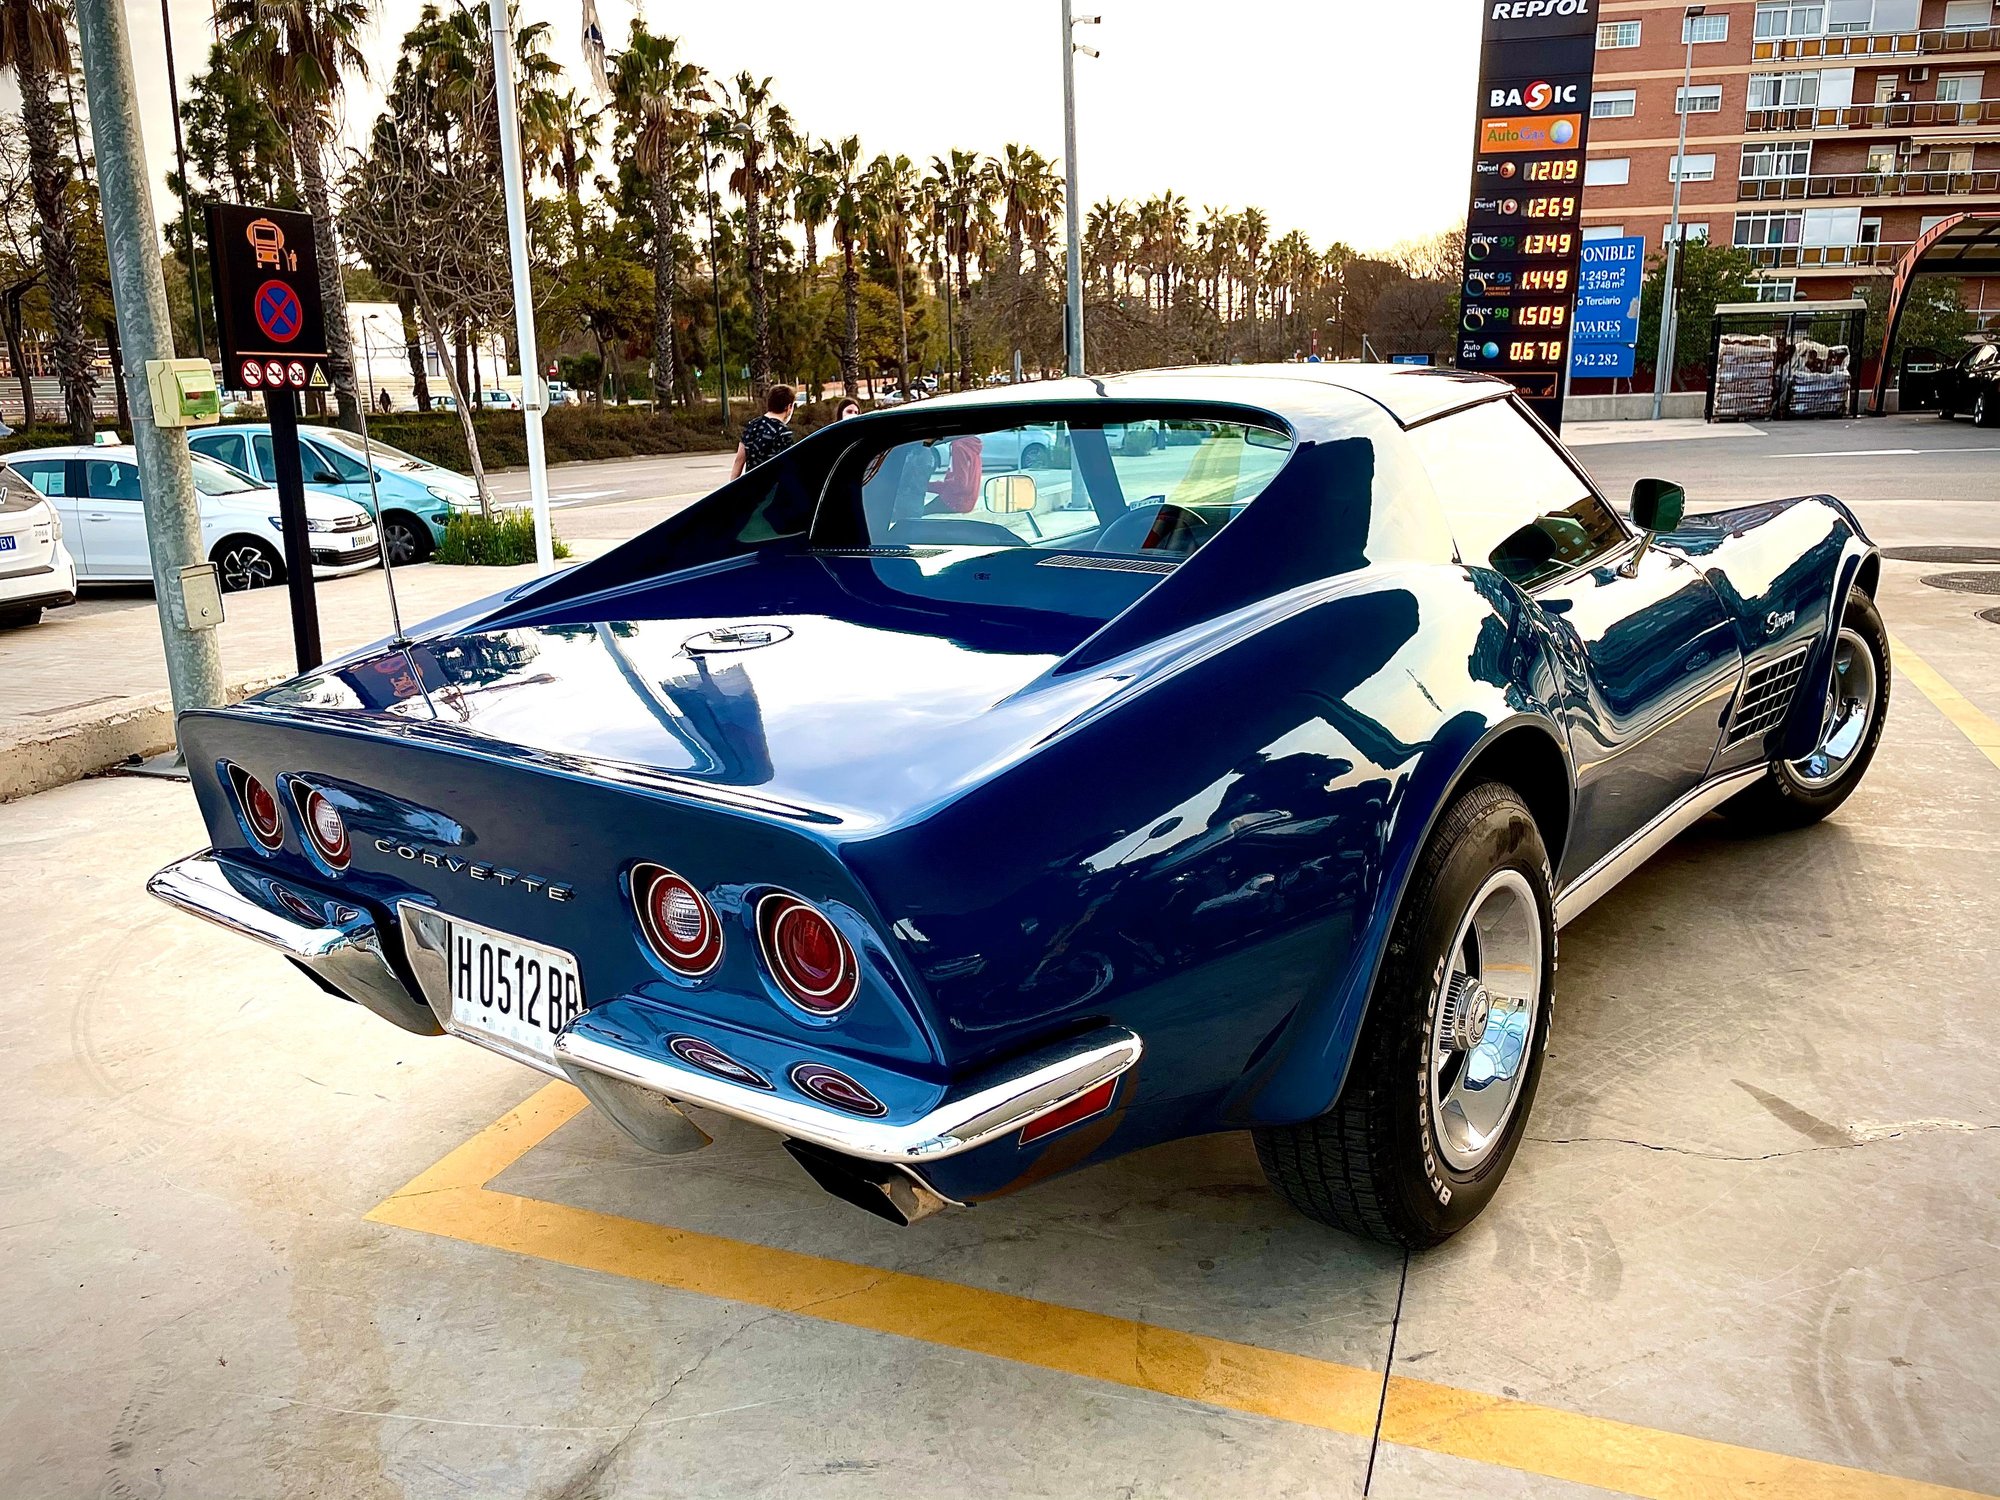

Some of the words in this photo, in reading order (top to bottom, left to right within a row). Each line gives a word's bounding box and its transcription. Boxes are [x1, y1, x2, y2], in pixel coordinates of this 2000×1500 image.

[1492, 0, 1588, 20] REPSOL
[1490, 81, 1577, 110] BASIC
[1477, 163, 1499, 173] Diesel
[1474, 201, 1496, 209] Diesel
[1500, 236, 1515, 247] 95
[1497, 272, 1512, 283] 95
[1494, 306, 1509, 318] 98
[1574, 320, 1621, 333] IVARES
[1463, 343, 1481, 351] Auto
[1462, 350, 1477, 358] Gas
[1597, 353, 1618, 366] 282
[374, 838, 576, 902] CORVETTE
